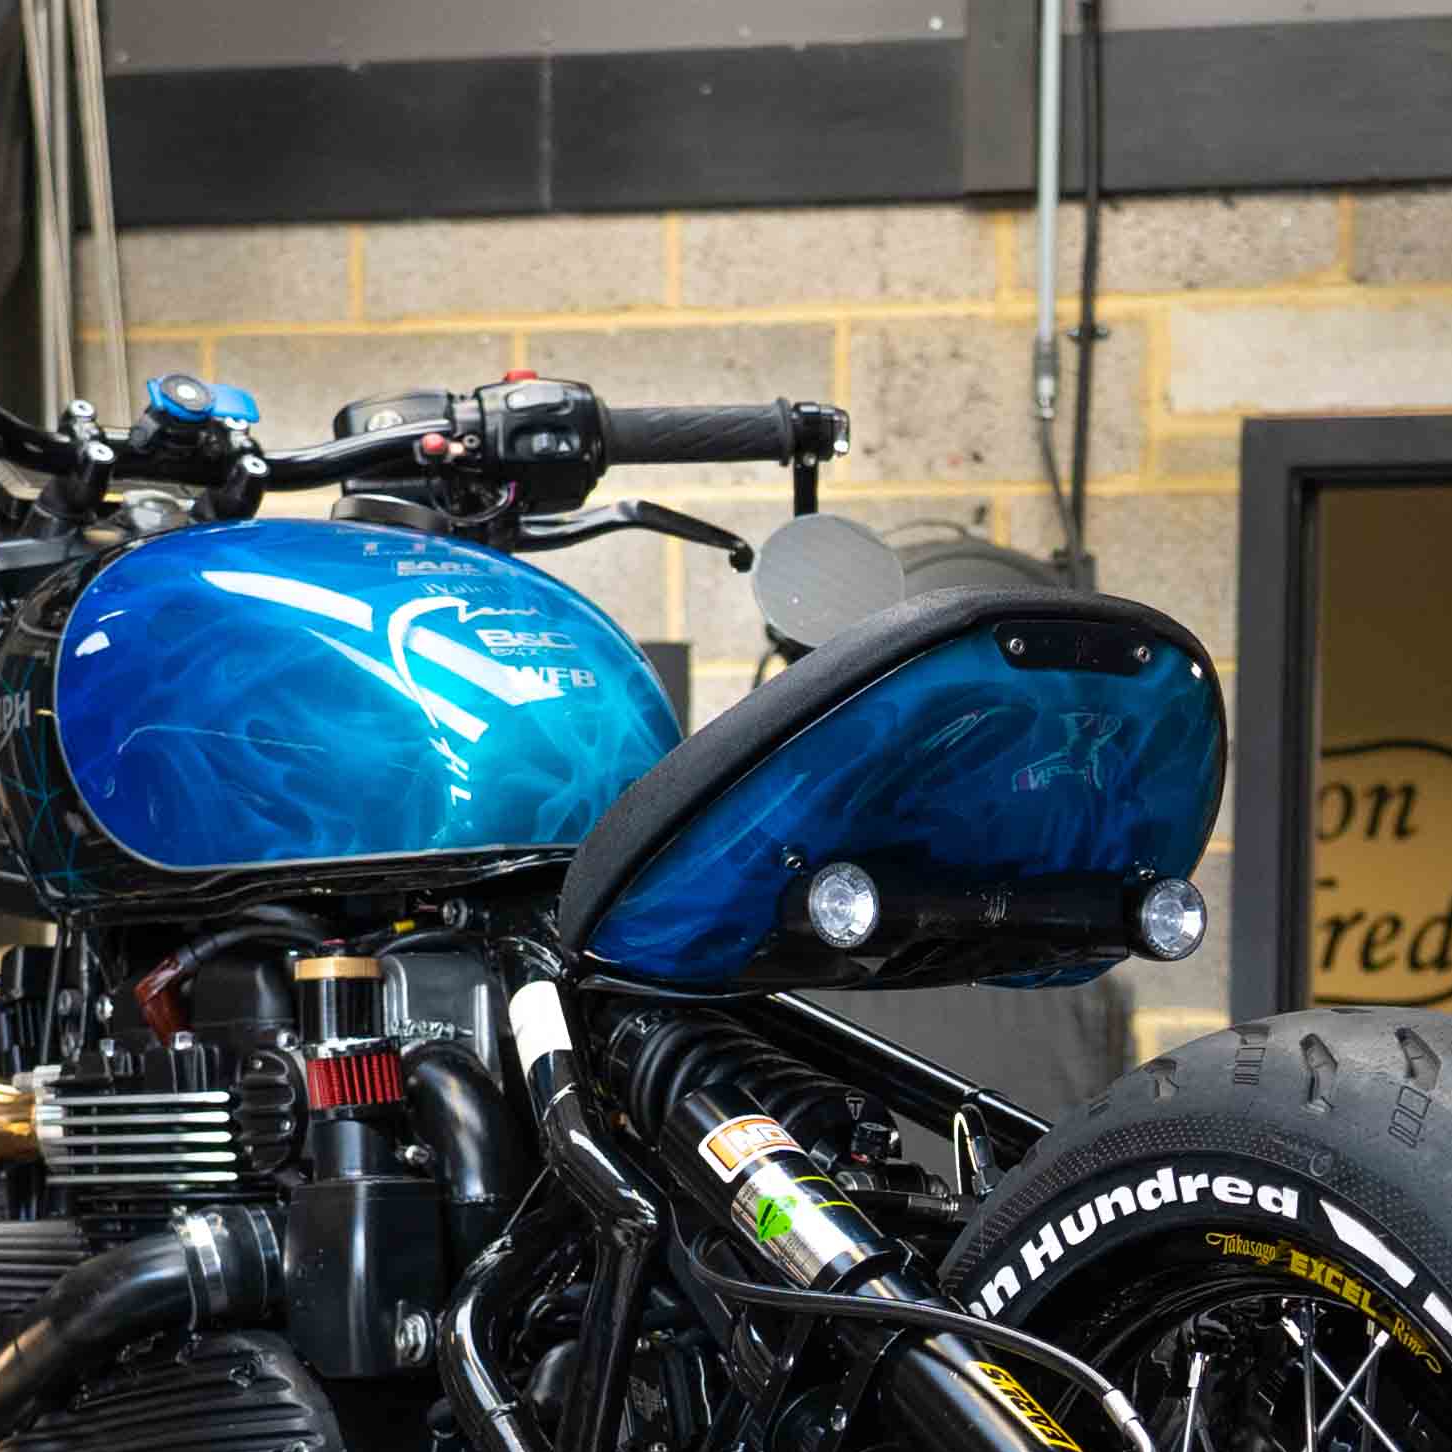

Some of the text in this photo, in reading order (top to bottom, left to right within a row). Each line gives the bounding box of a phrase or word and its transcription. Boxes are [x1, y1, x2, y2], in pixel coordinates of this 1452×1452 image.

[1020, 1167, 1299, 1281] Hundred
[1205, 1232, 1442, 1374] Takasago EXCEL Rim
